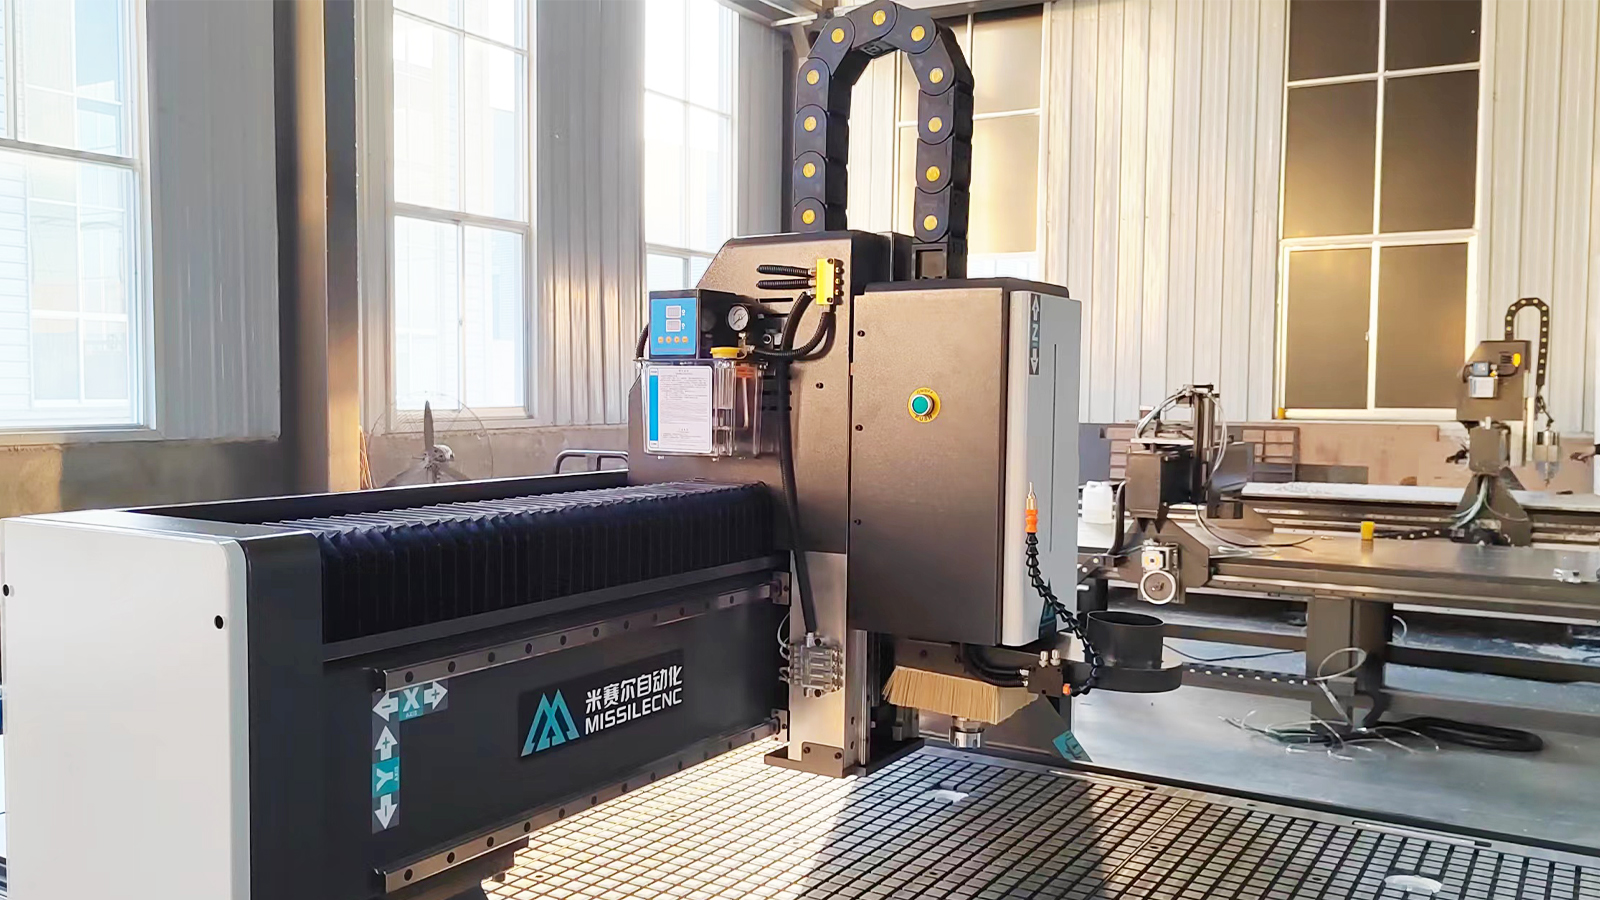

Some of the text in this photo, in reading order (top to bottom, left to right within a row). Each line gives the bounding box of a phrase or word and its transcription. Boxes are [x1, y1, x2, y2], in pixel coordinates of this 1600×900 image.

[1031, 323, 1039, 342] Z
[402, 686, 421, 713] X
[585, 665, 683, 715] 米赛尔自动化
[585, 687, 683, 735] MISSILECNC
[376, 767, 394, 792] Y
